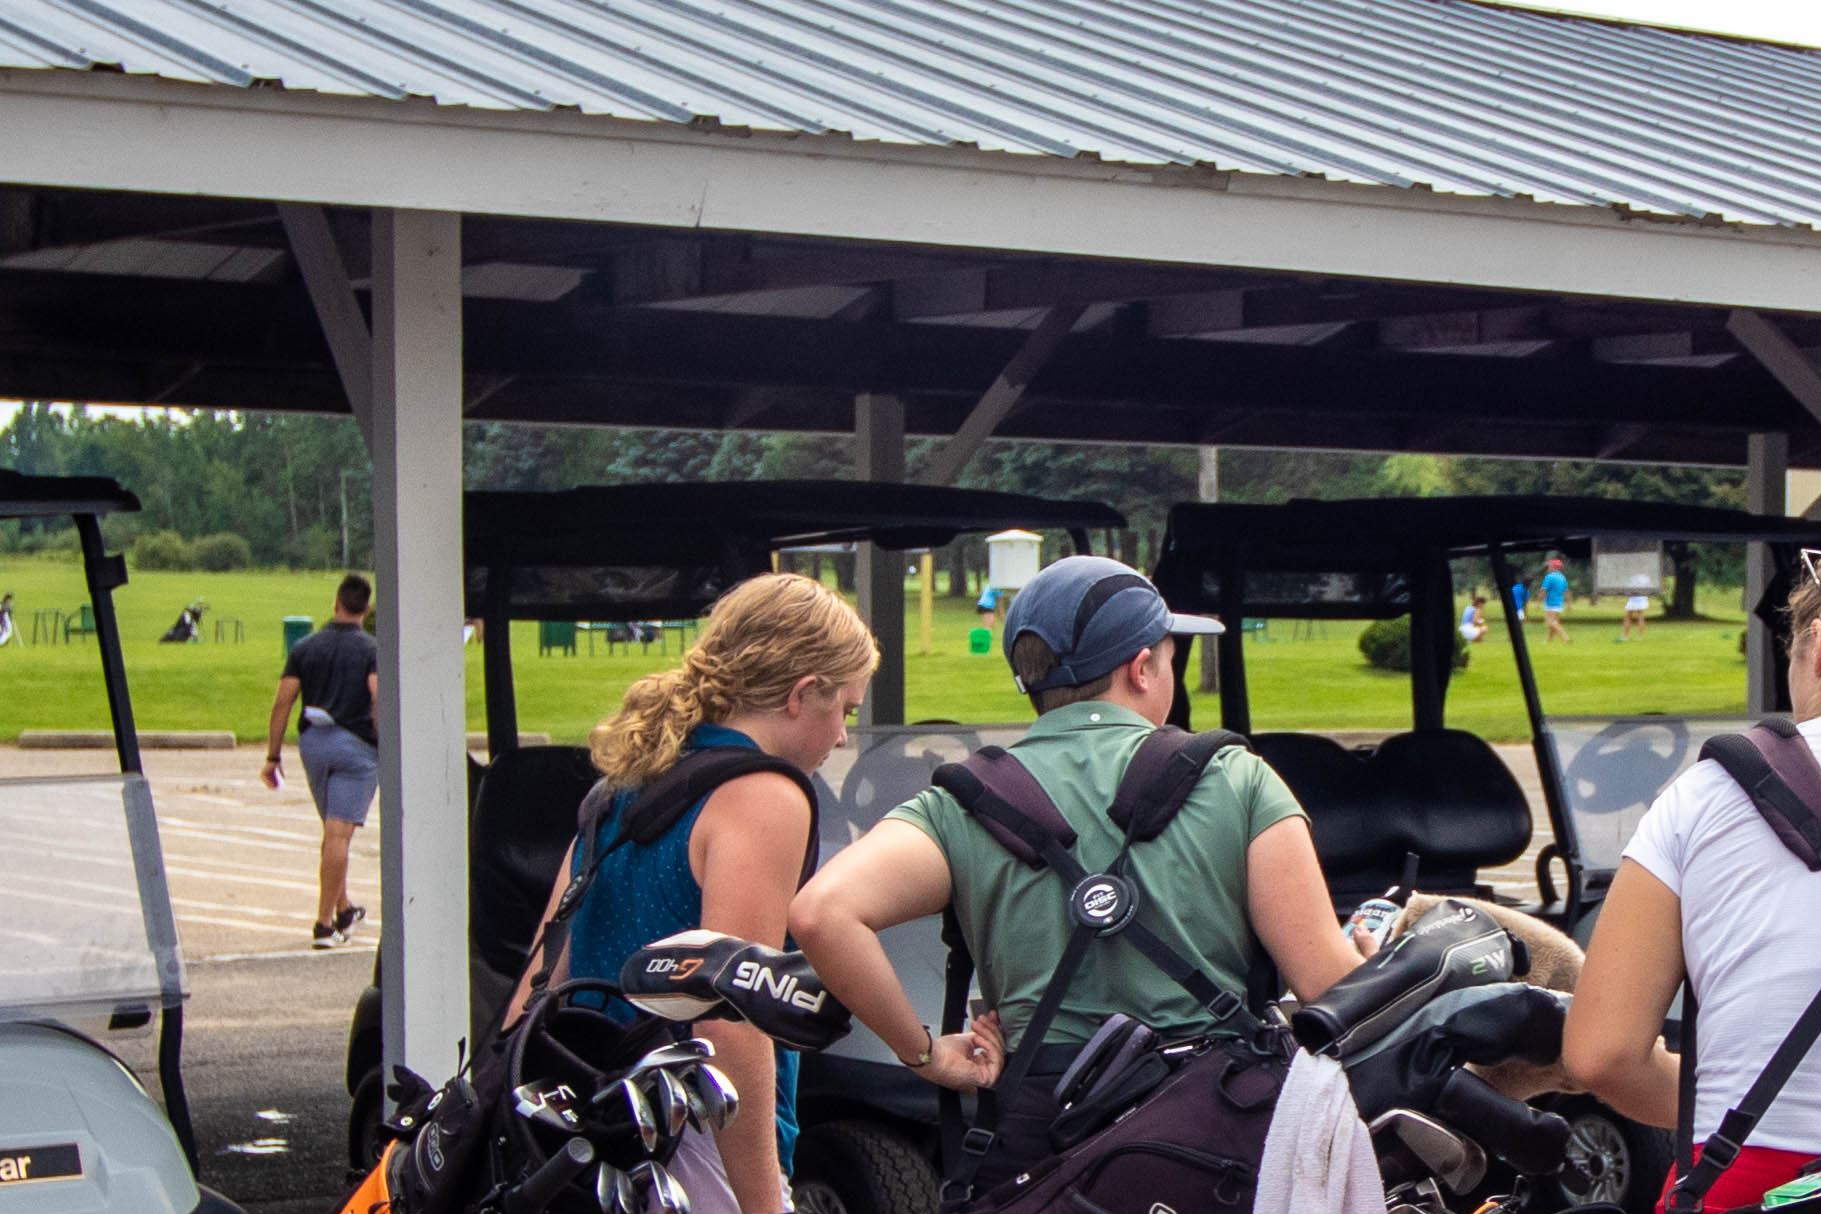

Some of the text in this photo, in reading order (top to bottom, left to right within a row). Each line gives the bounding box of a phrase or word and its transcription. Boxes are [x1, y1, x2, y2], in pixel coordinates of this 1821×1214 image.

[1083, 890, 1118, 911] DISC
[645, 957, 705, 981] G400
[731, 960, 828, 1015] PING
